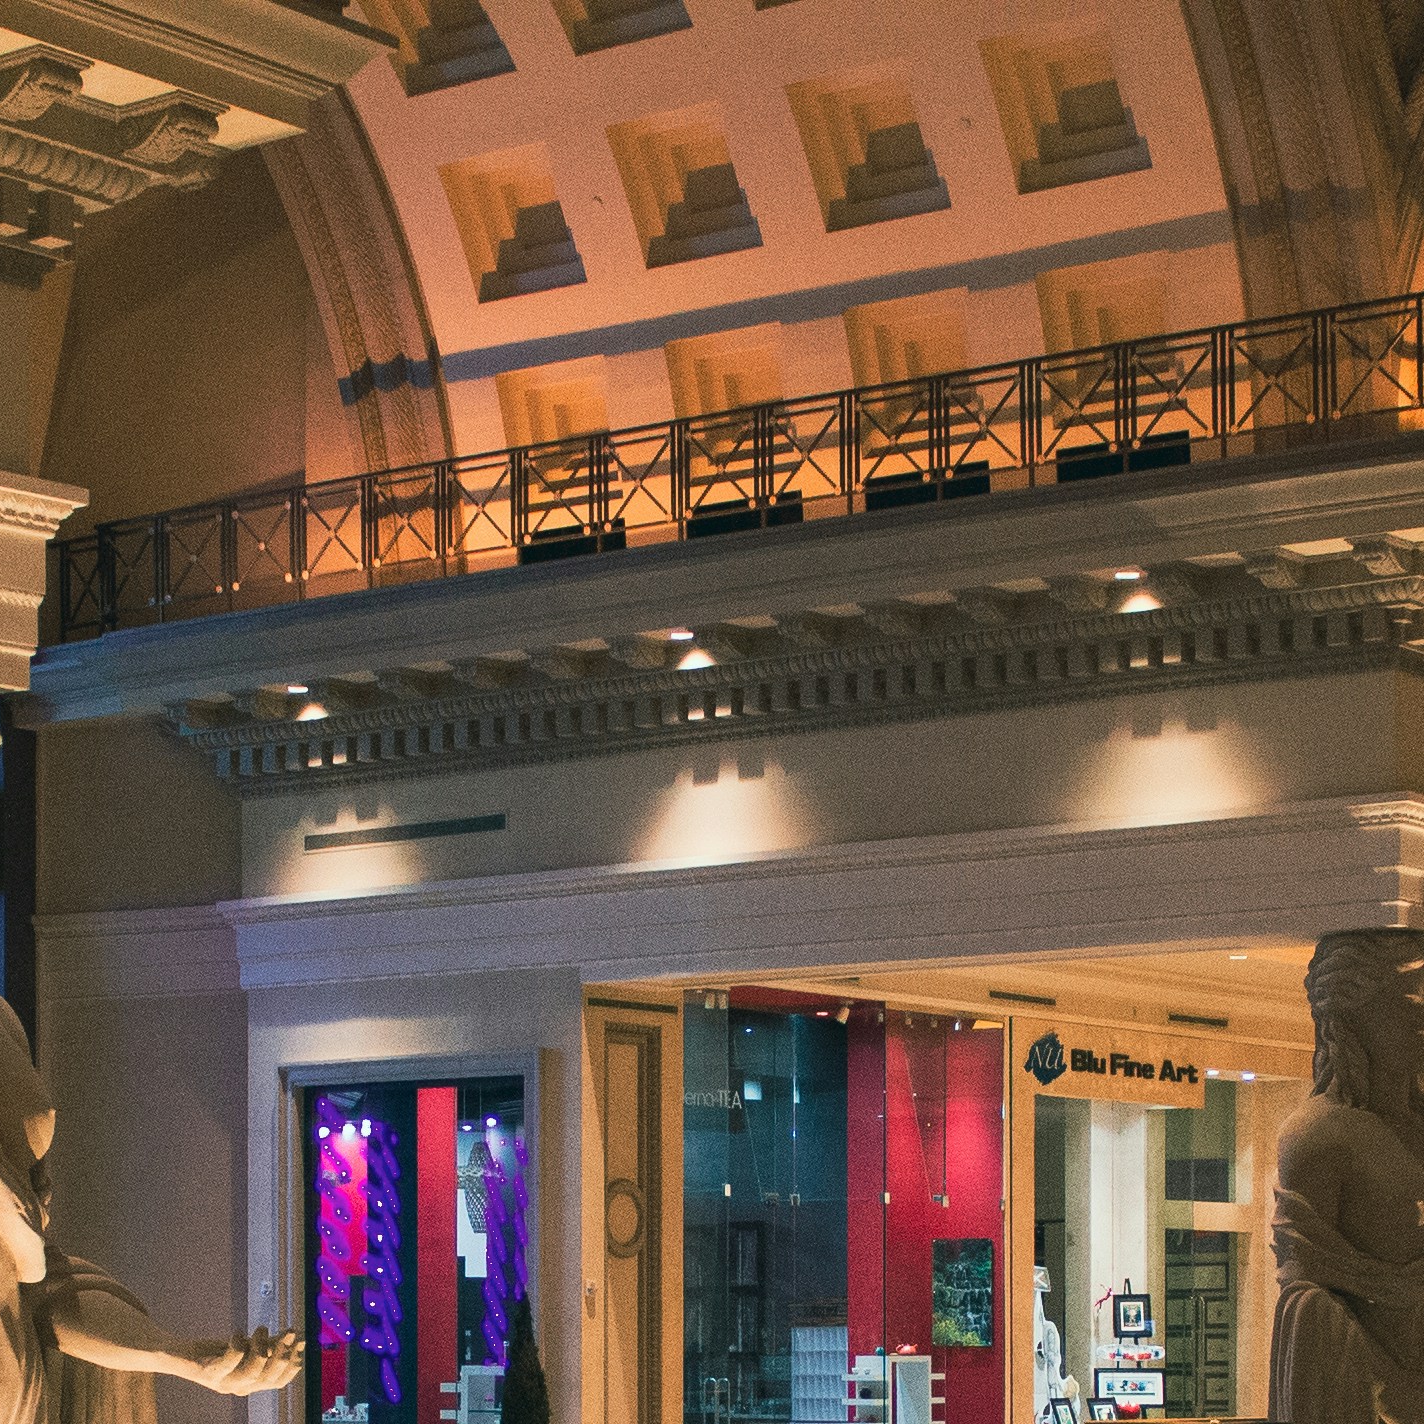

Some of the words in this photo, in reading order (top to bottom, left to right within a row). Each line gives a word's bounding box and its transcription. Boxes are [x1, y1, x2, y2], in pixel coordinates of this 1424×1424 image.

[1071, 1048, 1106, 1075] Blu
[1110, 1053, 1155, 1079] Fine
[1158, 1059, 1199, 1083] Art
